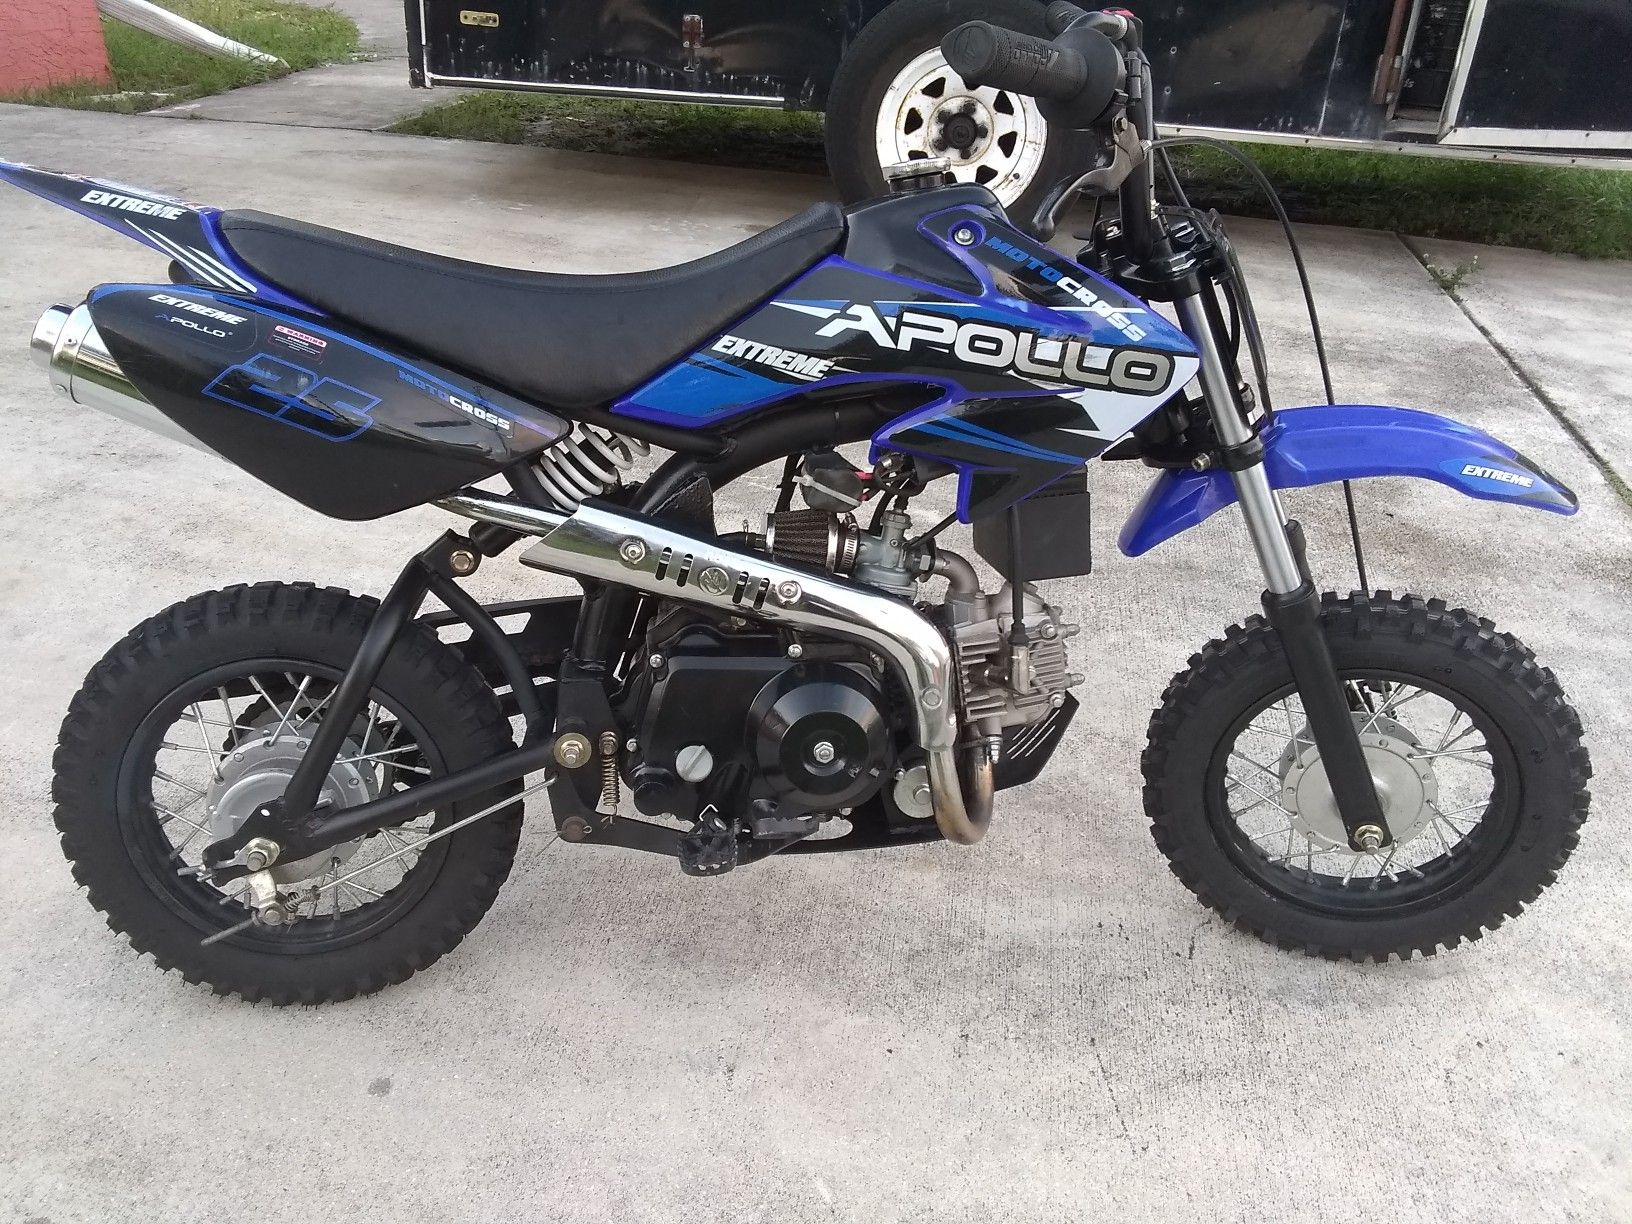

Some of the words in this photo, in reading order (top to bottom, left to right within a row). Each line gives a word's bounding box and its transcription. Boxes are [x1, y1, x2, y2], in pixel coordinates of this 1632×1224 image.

[80, 189, 188, 221] EXTREME
[147, 293, 248, 325] EXTREME
[154, 312, 226, 338] APOLLO
[711, 334, 835, 378] EXTREME
[814, 303, 1168, 396] APOLLO
[398, 369, 510, 430] MOTOCROSS
[1461, 464, 1534, 488] EXTREME
